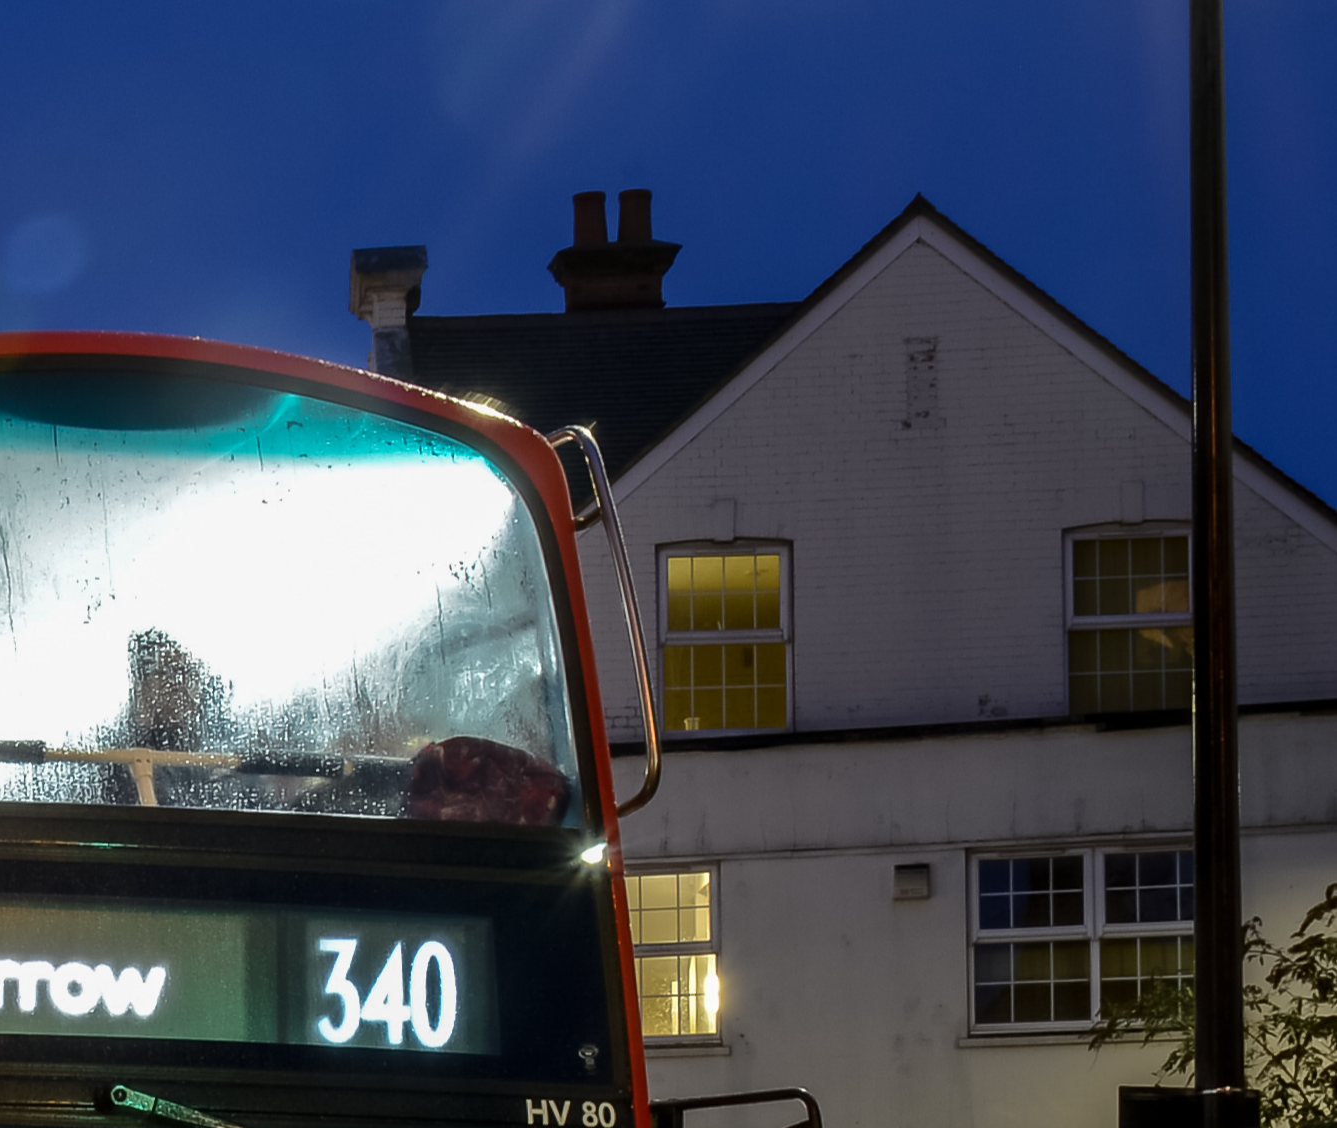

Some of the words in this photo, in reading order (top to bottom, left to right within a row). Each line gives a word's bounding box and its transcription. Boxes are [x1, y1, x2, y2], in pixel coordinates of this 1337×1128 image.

[317, 938, 457, 1048] 340
[526, 1099, 571, 1126] HV
[582, 1101, 616, 1128] 80
